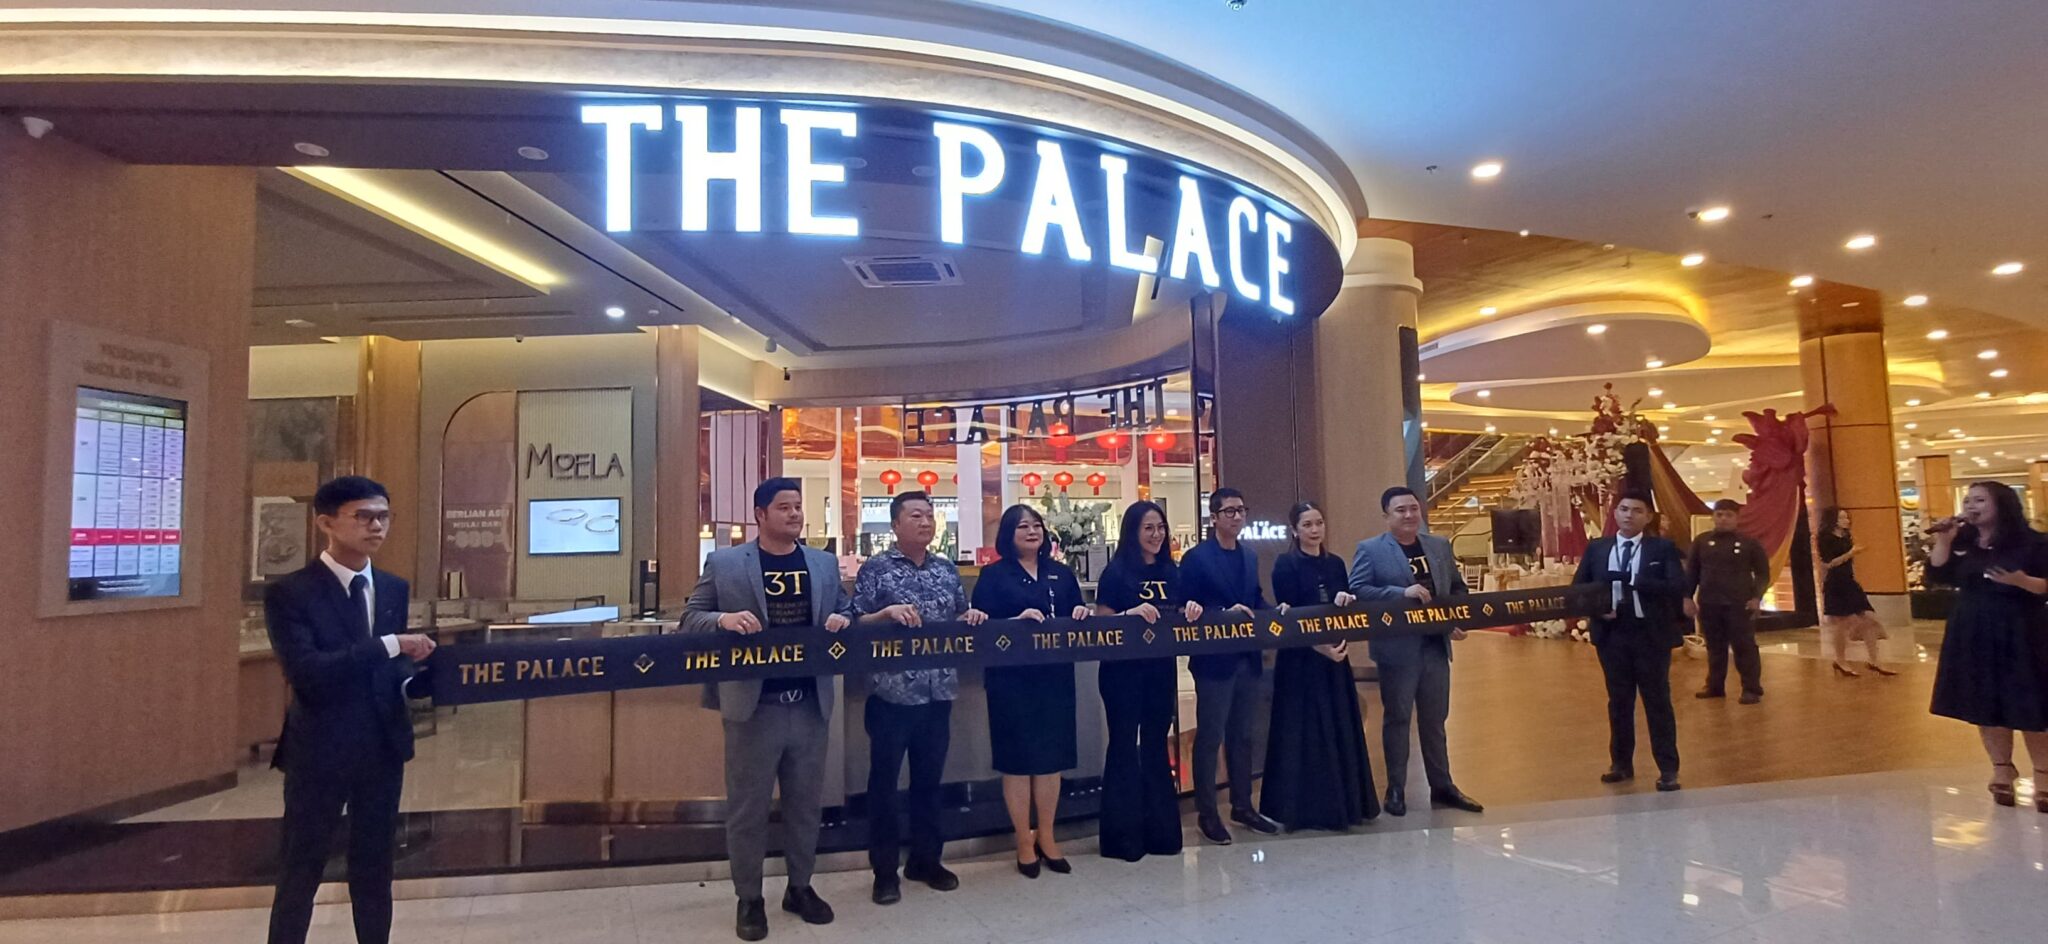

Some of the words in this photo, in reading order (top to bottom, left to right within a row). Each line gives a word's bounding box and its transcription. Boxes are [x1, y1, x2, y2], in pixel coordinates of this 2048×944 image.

[580, 104, 859, 236] THE
[933, 121, 1295, 315] PALACE
[764, 570, 808, 596] 3T
[1138, 580, 1168, 600] 3T
[1404, 609, 1426, 624] THE
[1427, 605, 1471, 622] PALACE
[1505, 600, 1526, 614] THE
[1173, 626, 1200, 642] THE
[1204, 622, 1256, 640] PALACE
[1297, 618, 1322, 634] THE
[1325, 613, 1369, 631] PALACE
[870, 639, 903, 658] THE
[911, 636, 974, 656] PALACE
[1031, 632, 1061, 649] THE
[1068, 629, 1123, 647] PALACE
[684, 649, 721, 671] THE
[731, 642, 804, 666] PALACE
[458, 661, 505, 686] THE
[516, 656, 605, 681] PALACE
